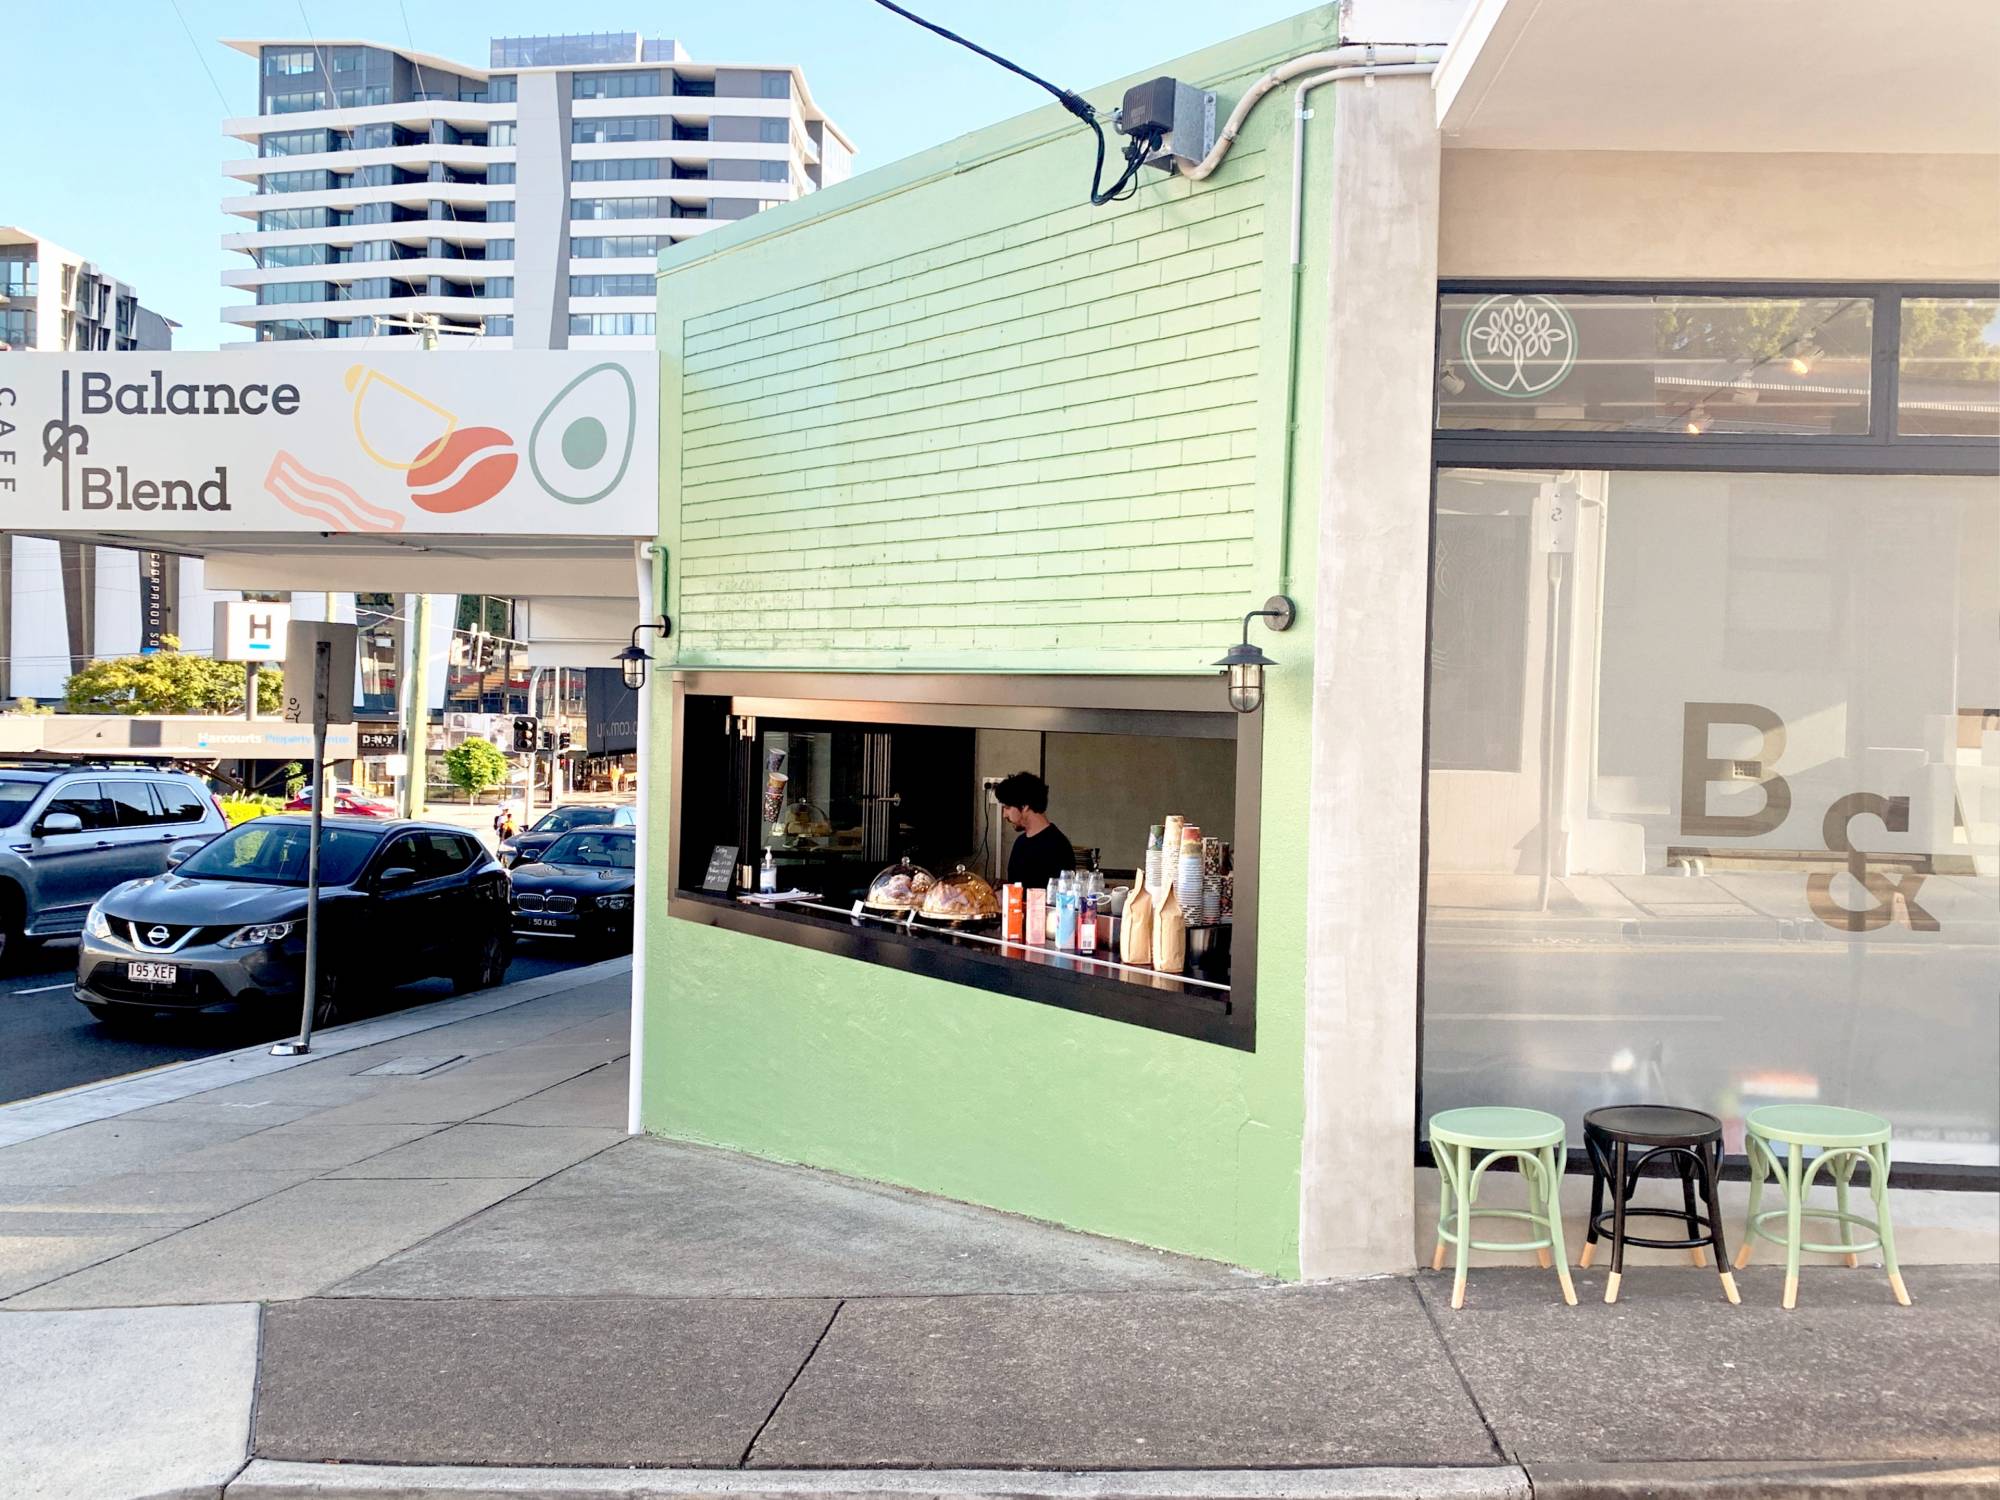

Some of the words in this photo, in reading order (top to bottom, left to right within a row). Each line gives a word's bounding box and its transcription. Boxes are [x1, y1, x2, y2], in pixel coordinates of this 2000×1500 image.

[81, 370, 301, 415] Balance
[81, 466, 232, 511] Blend
[249, 614, 272, 640] H
[197, 732, 262, 744] Harcourts
[1681, 702, 1792, 838] B
[1806, 792, 1941, 932] &
